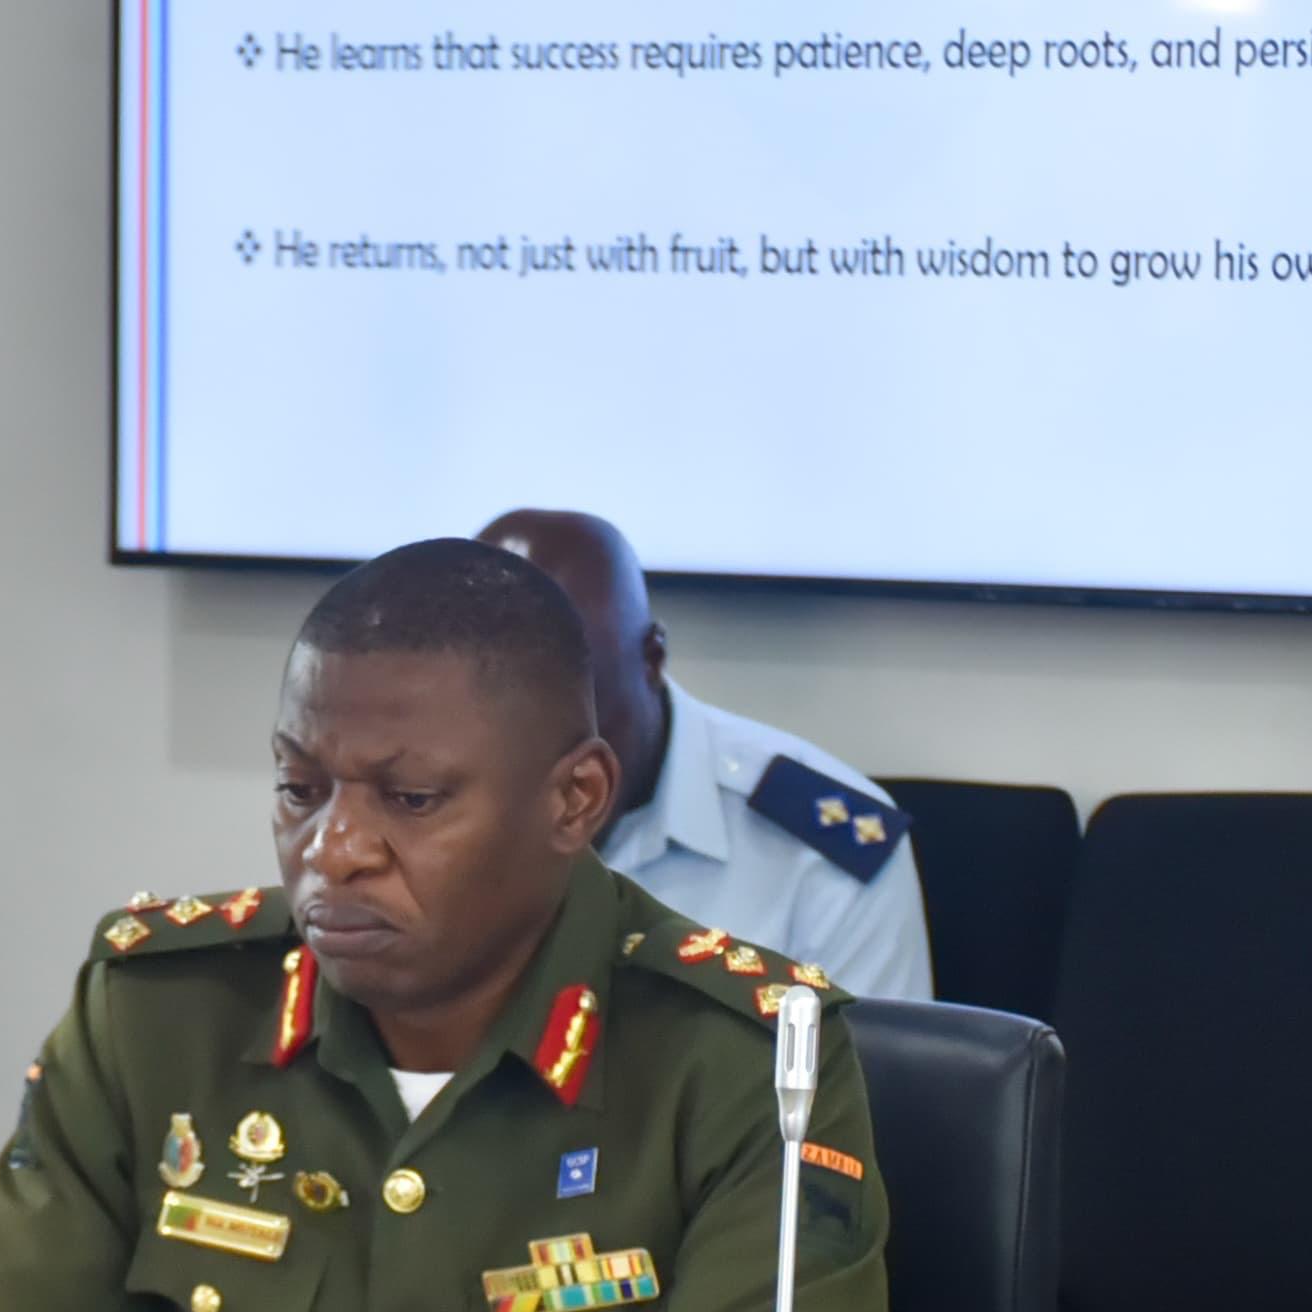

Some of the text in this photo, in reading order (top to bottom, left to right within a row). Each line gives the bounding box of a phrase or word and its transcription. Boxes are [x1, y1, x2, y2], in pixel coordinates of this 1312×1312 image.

[277, 34, 320, 70] He
[331, 33, 422, 70] learns
[432, 32, 500, 70] that
[511, 37, 619, 69] success
[630, 34, 762, 77] requires
[775, 31, 930, 77] patience,
[943, 28, 1032, 77] deep
[1044, 31, 1138, 72] roots,
[1151, 27, 1222, 69] and
[276, 231, 319, 269] He
[329, 236, 446, 273] returns,
[458, 237, 509, 271] not
[520, 237, 575, 276] just
[587, 234, 658, 273] with
[669, 233, 748, 277] fruit,
[760, 234, 818, 275] but
[830, 235, 904, 277] with
[917, 236, 1049, 279] wisdom
[1062, 241, 1098, 279] to
[1110, 250, 1201, 287] grow
[1215, 239, 1259, 281] his
